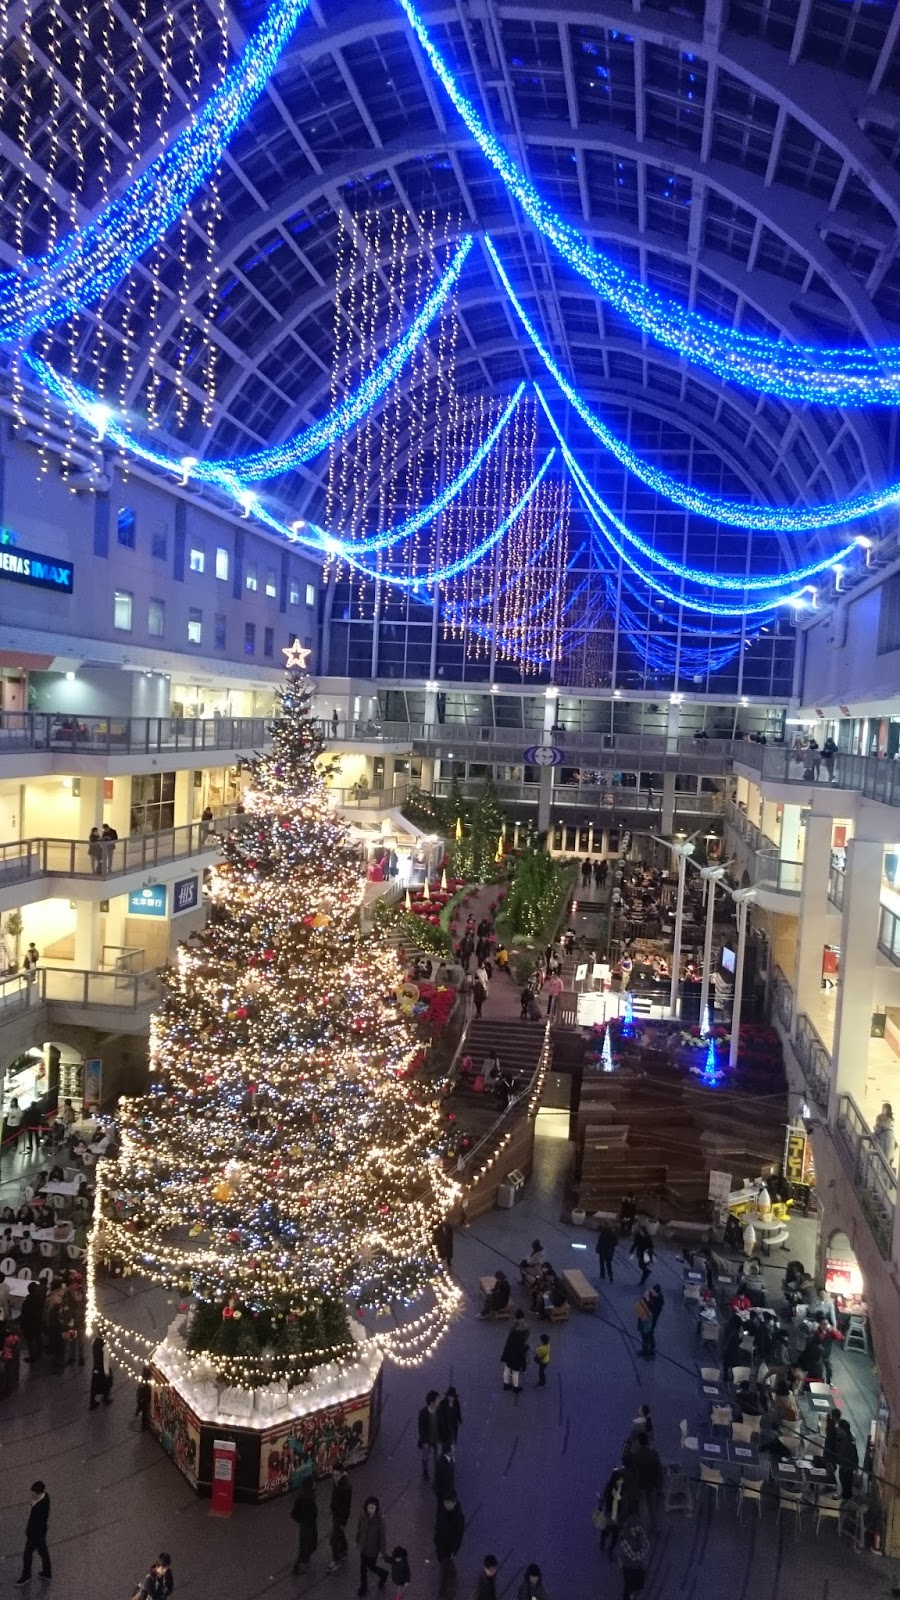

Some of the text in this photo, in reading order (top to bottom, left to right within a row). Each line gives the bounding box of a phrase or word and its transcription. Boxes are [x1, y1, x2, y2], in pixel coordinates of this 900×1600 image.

[31, 560, 71, 586] IMAX
[131, 897, 163, 907] 北洋銀行
